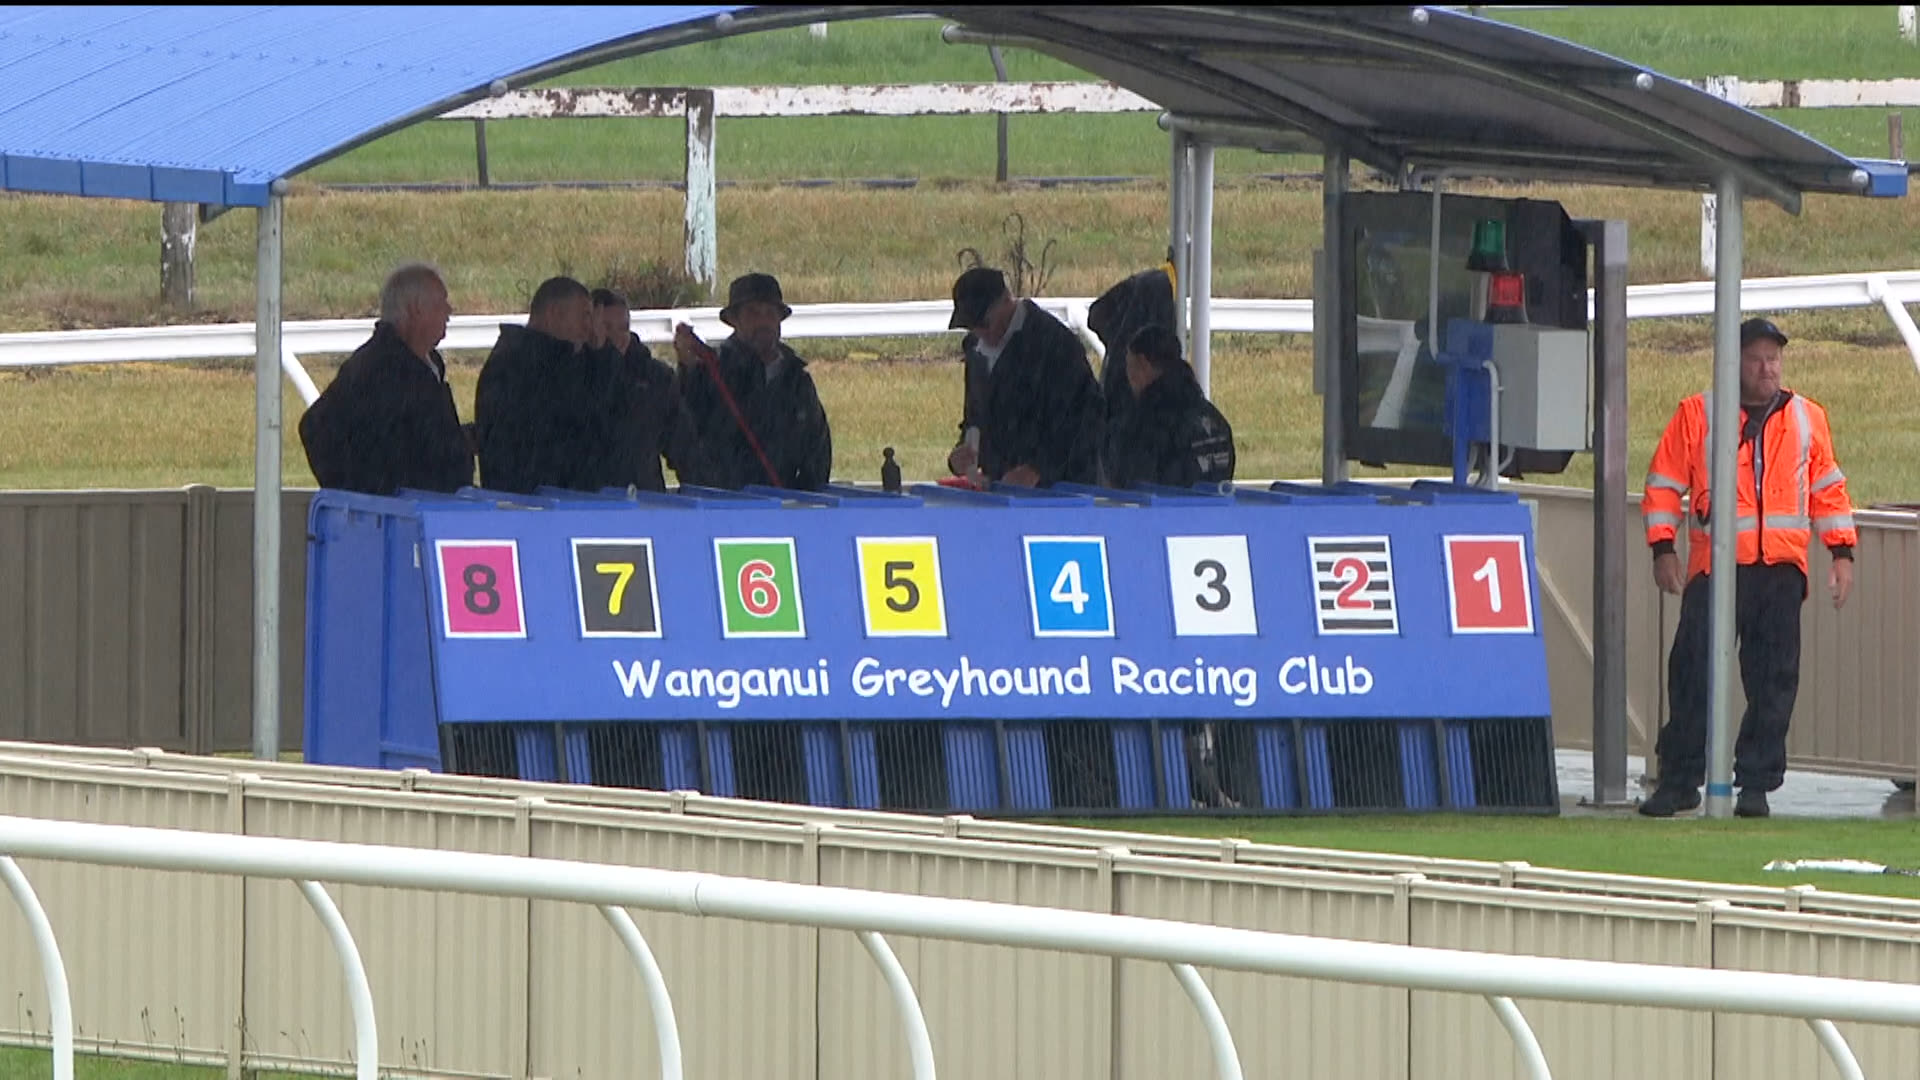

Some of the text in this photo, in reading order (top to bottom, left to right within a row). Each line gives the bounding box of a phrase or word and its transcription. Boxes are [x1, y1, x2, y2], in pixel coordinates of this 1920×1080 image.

[463, 563, 501, 615] 8
[595, 562, 635, 615] 7
[737, 560, 781, 618] 6
[884, 561, 920, 613] 5
[1050, 560, 1089, 614] 4
[1194, 559, 1231, 611] 3
[1332, 558, 1374, 610] 2
[1472, 556, 1502, 612] 1
[613, 654, 1374, 709] Wanganui Greyhound Racing Club
